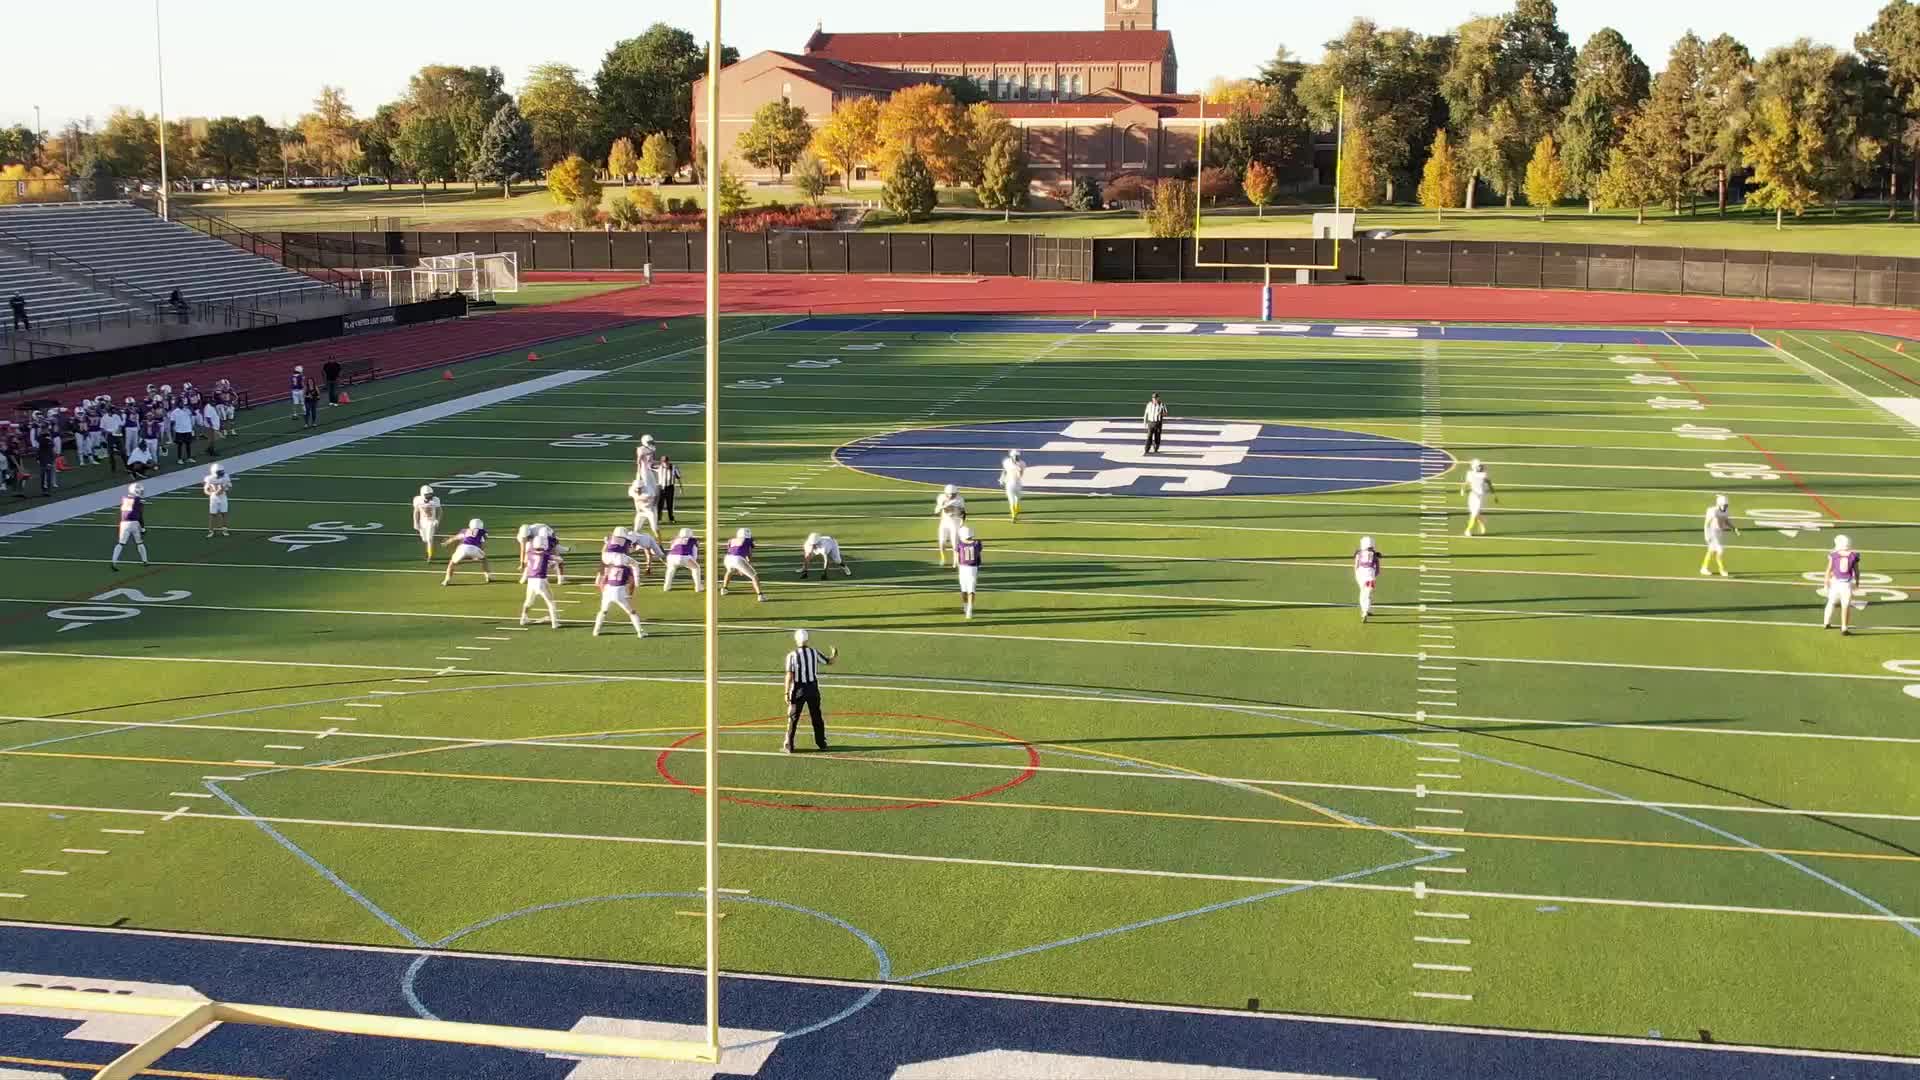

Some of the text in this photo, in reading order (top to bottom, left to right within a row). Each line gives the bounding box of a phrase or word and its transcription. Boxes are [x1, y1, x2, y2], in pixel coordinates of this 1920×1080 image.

[1096, 322, 1418, 339] DPS
[266, 521, 383, 544] 30
[46, 588, 192, 621] 20
